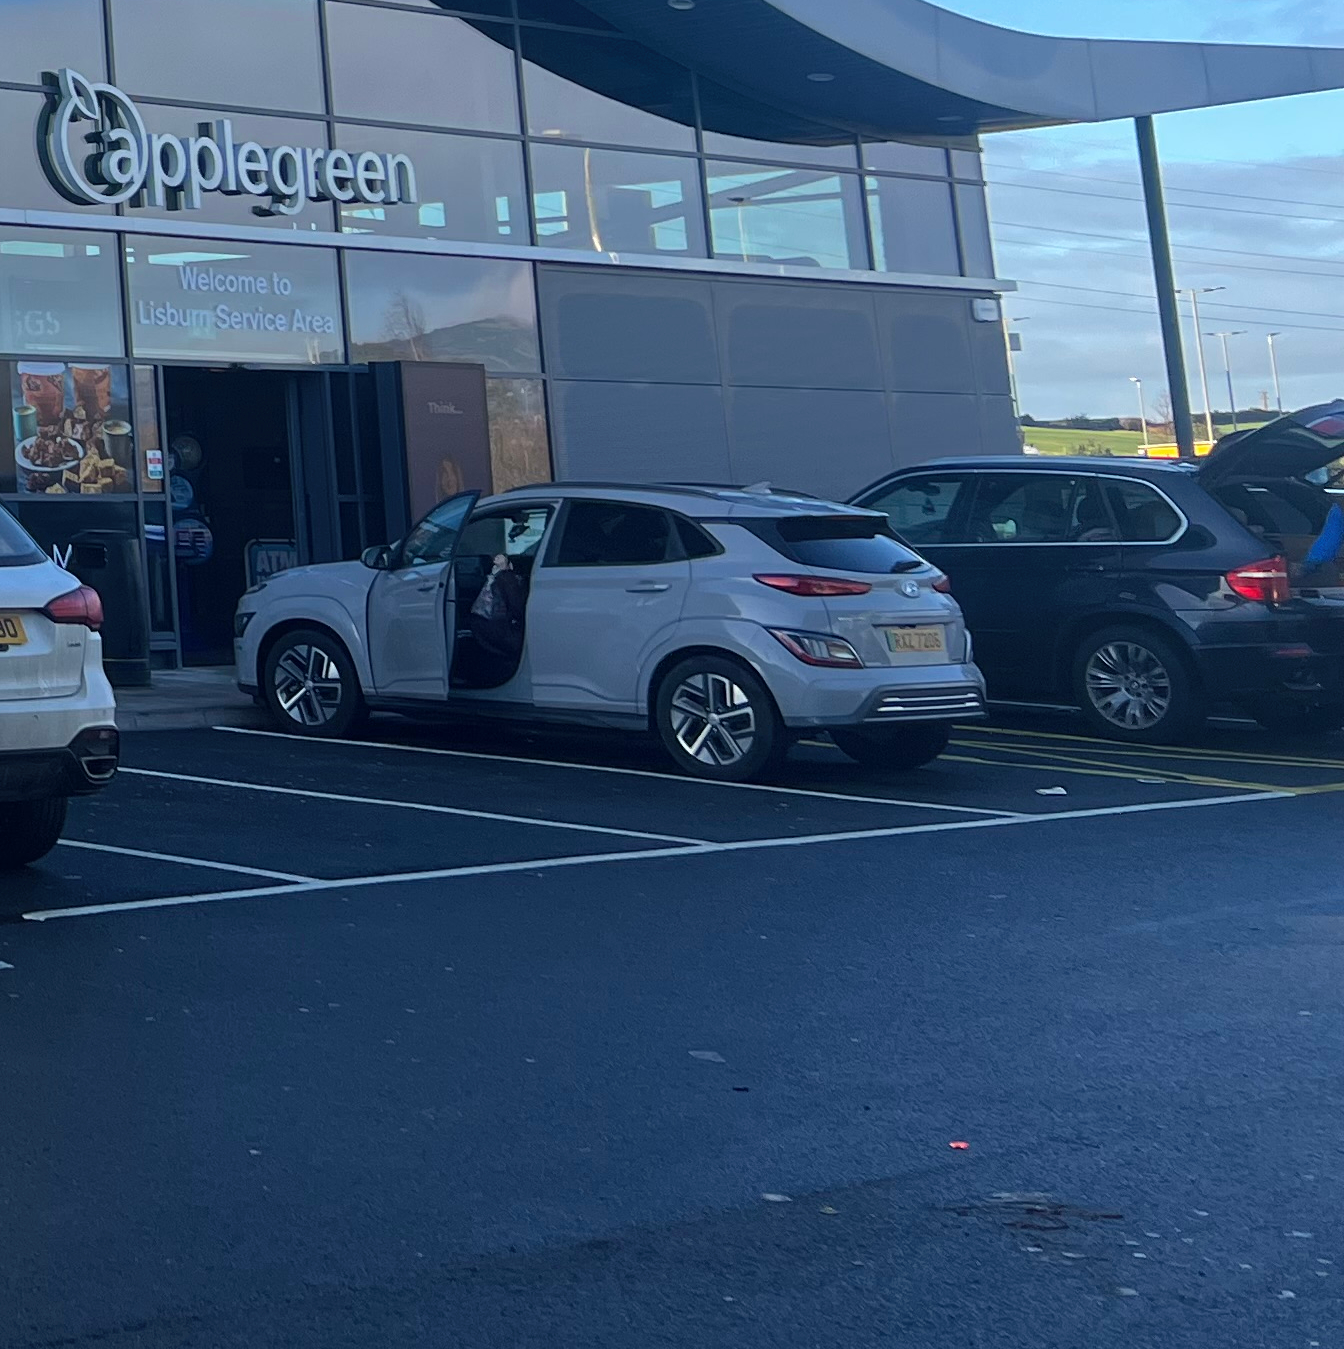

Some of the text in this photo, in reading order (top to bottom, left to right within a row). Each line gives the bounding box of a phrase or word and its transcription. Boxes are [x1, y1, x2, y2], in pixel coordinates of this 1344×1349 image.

[100, 118, 418, 215] applegreen
[179, 265, 292, 296] Welcome to
[138, 300, 335, 334] Lisburn Service Area
